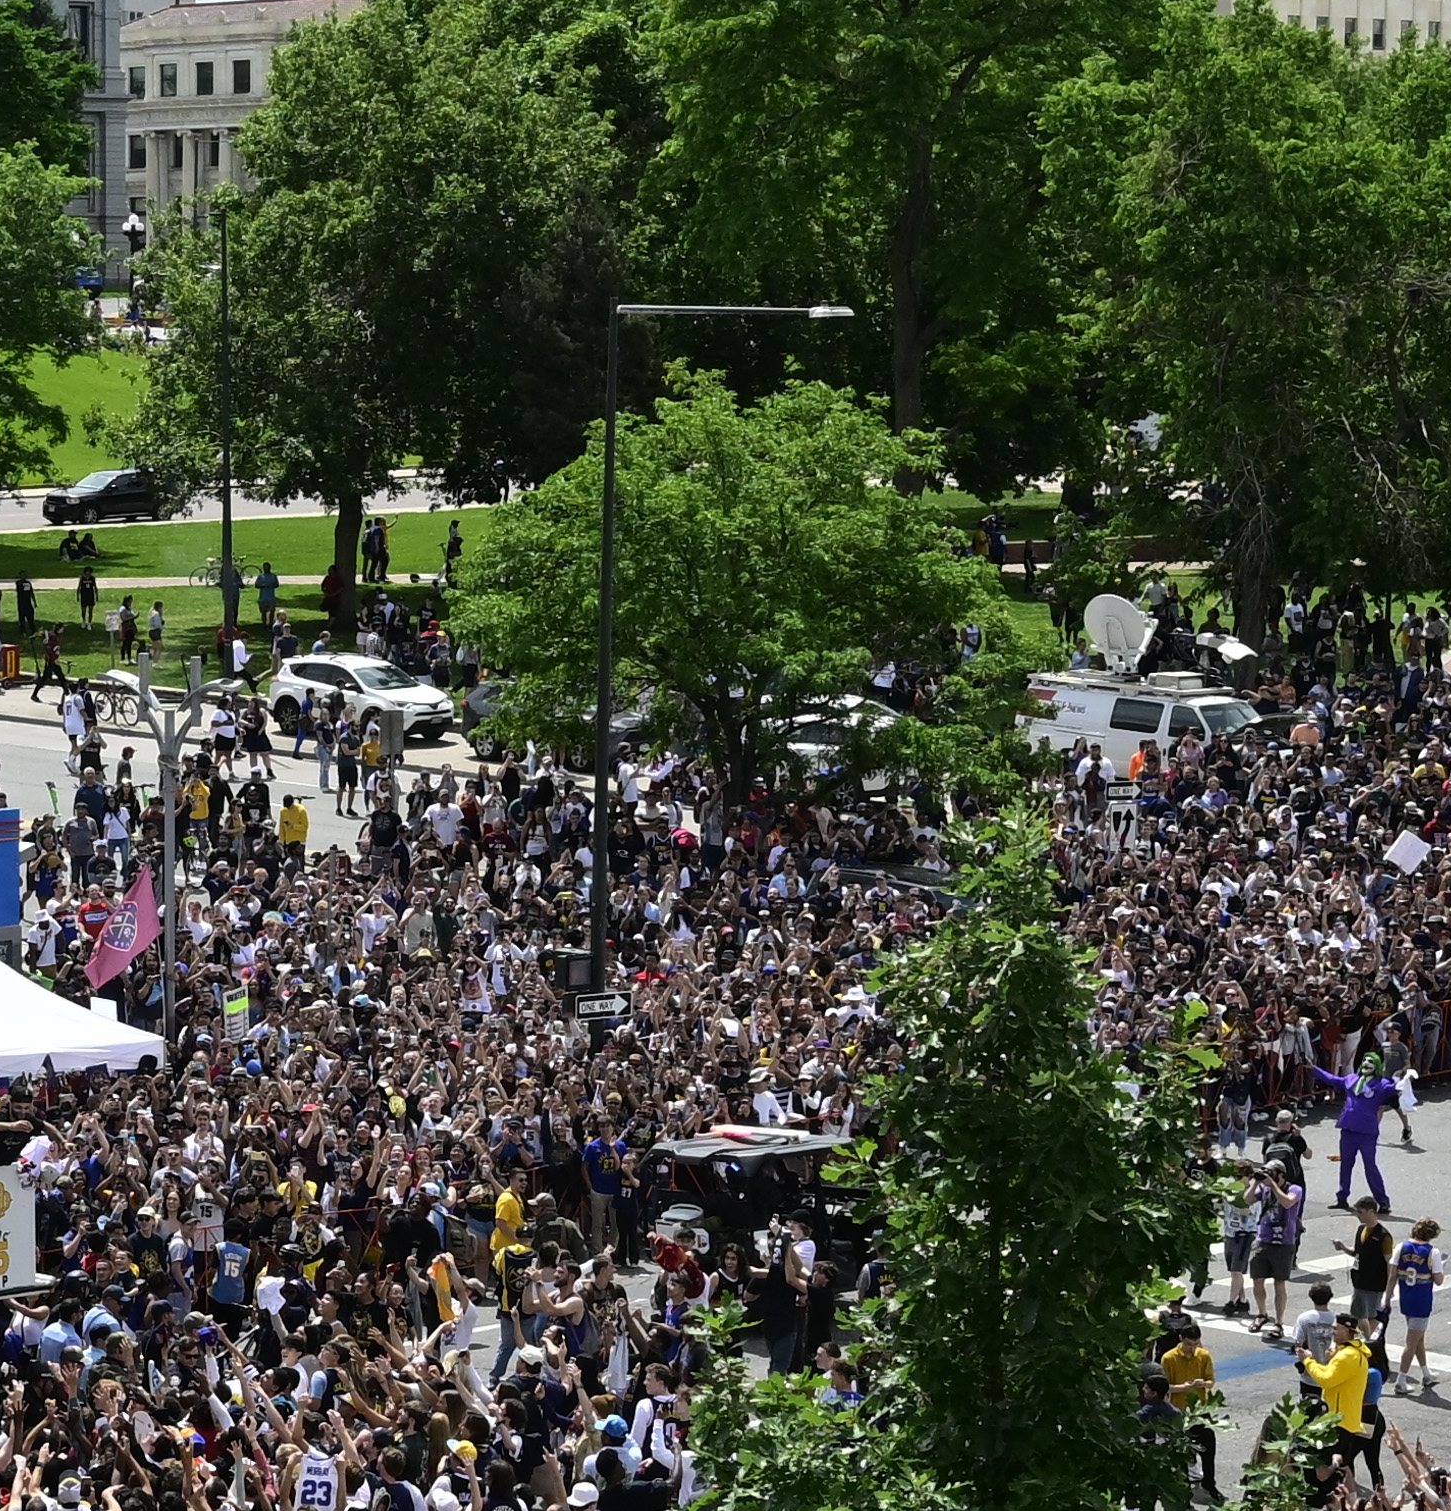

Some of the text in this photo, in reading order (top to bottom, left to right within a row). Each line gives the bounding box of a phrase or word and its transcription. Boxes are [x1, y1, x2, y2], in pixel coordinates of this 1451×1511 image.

[1109, 785, 1134, 795] ONE WAY
[581, 1000, 615, 1011] ONE WAY
[603, 1159, 614, 1169] 27
[200, 1206, 213, 1218] 15
[224, 1261, 239, 1275] 15
[1405, 1267, 1418, 1286] 3
[301, 1480, 331, 1506] 23
